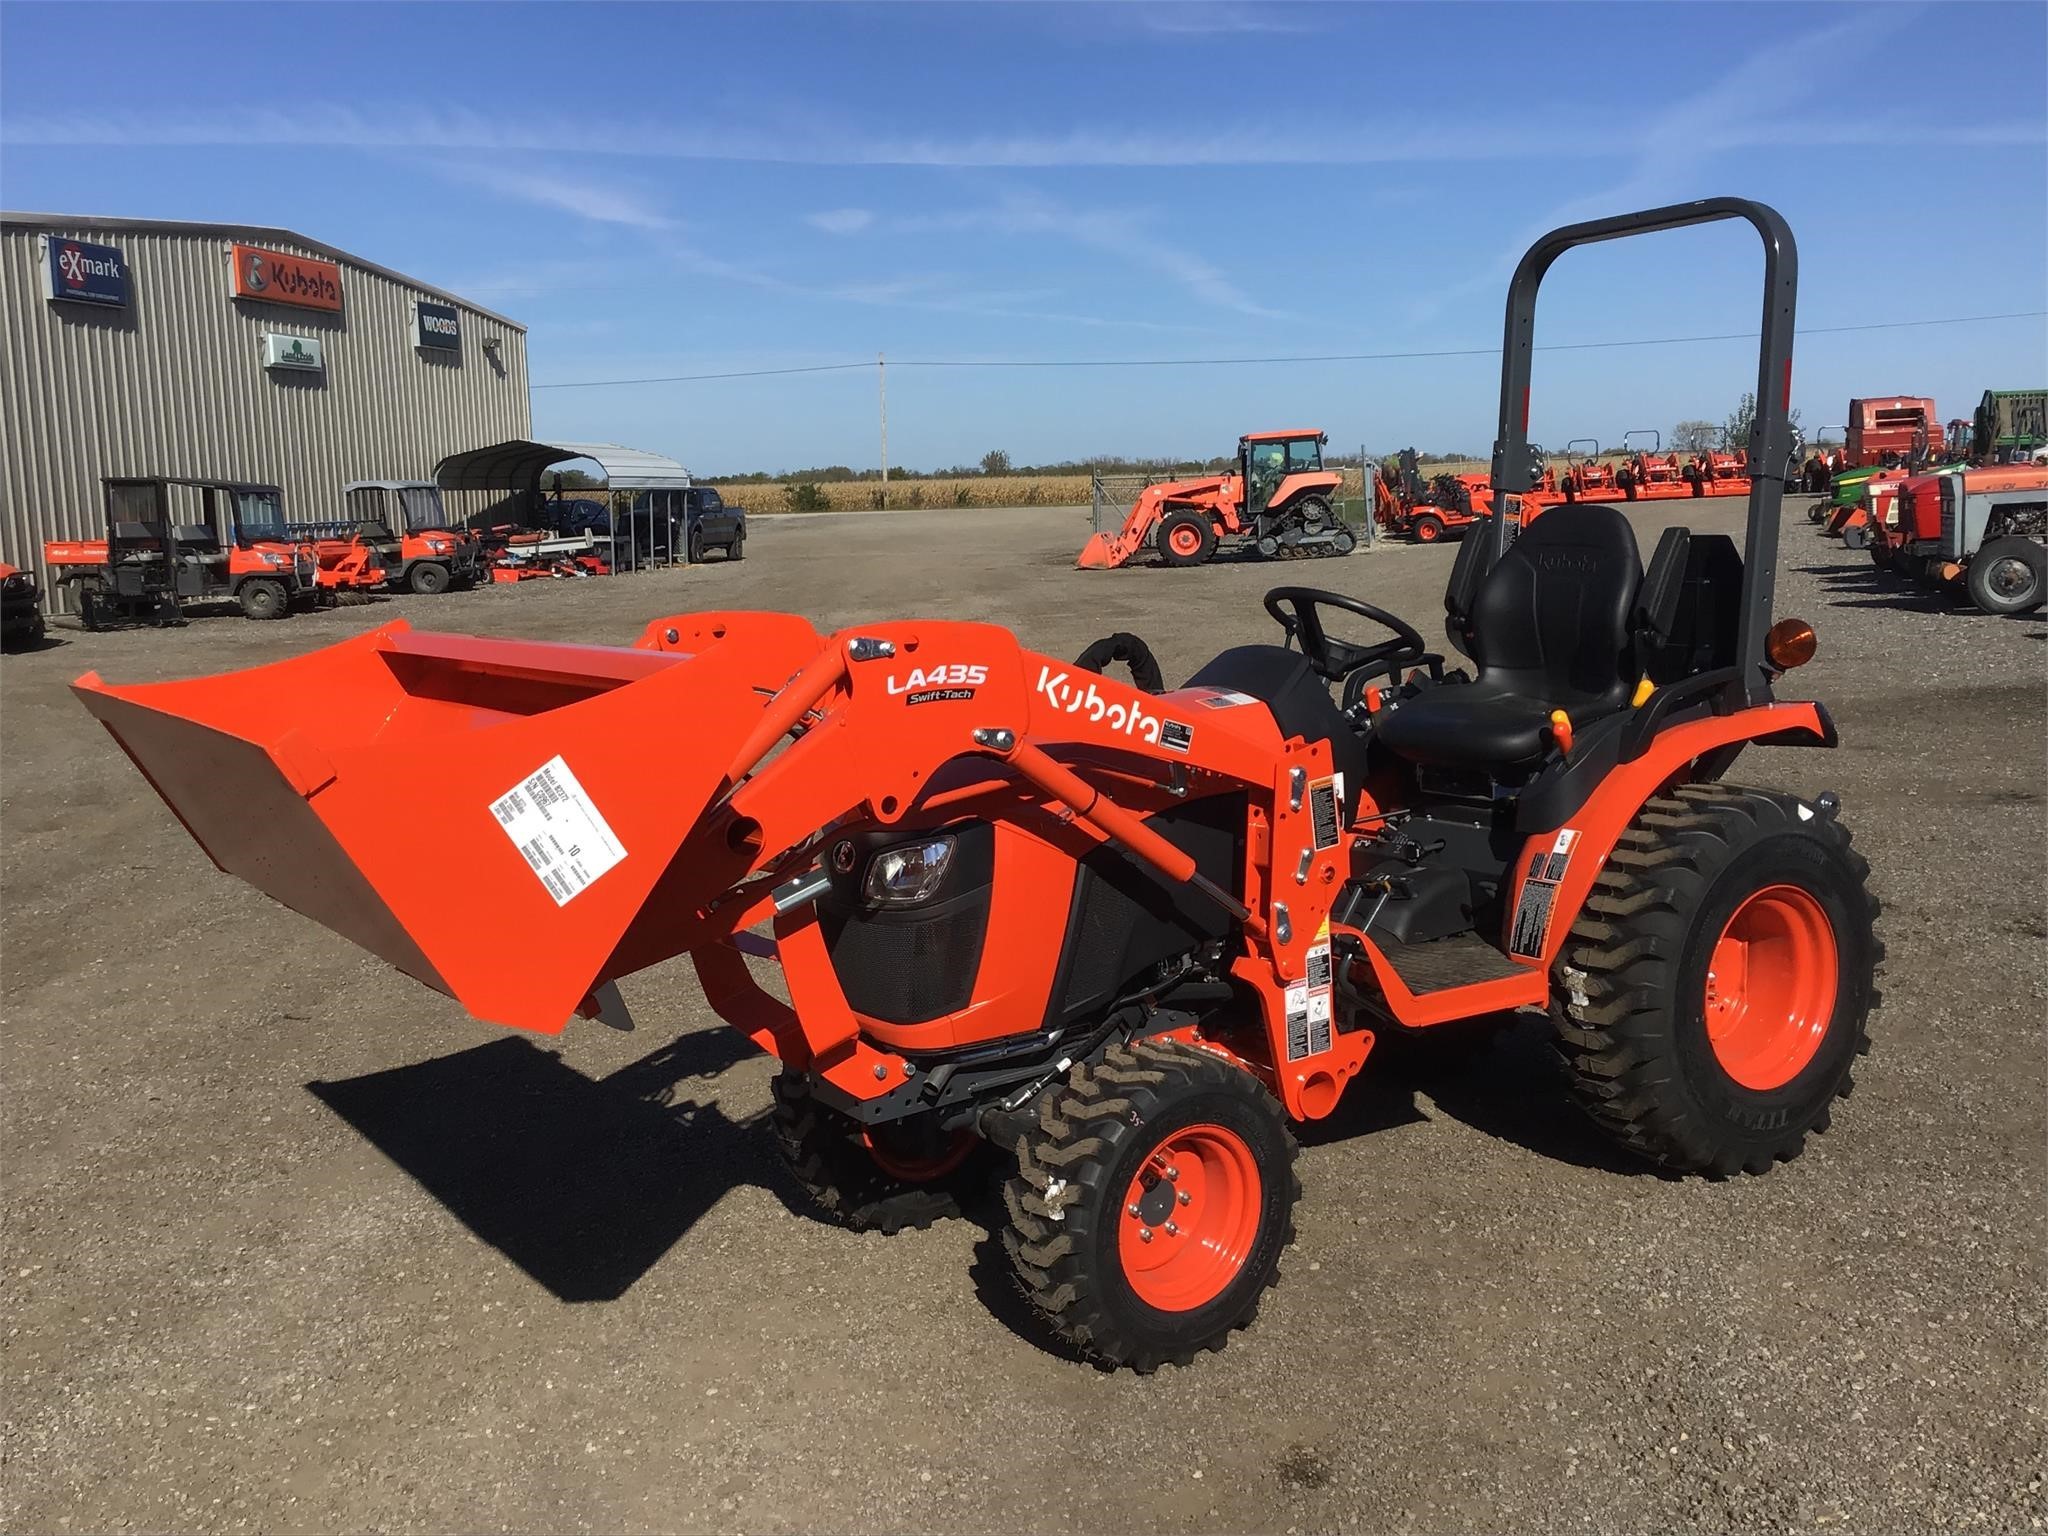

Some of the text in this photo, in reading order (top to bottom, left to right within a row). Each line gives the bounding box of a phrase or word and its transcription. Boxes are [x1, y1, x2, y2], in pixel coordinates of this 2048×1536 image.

[271, 262, 336, 300] Kubota
[423, 315, 457, 336] WOODS
[887, 664, 989, 695] LA435
[910, 689, 972, 704] Swift-Tach
[1036, 665, 1160, 744] Kubota
[568, 844, 581, 857] 10
